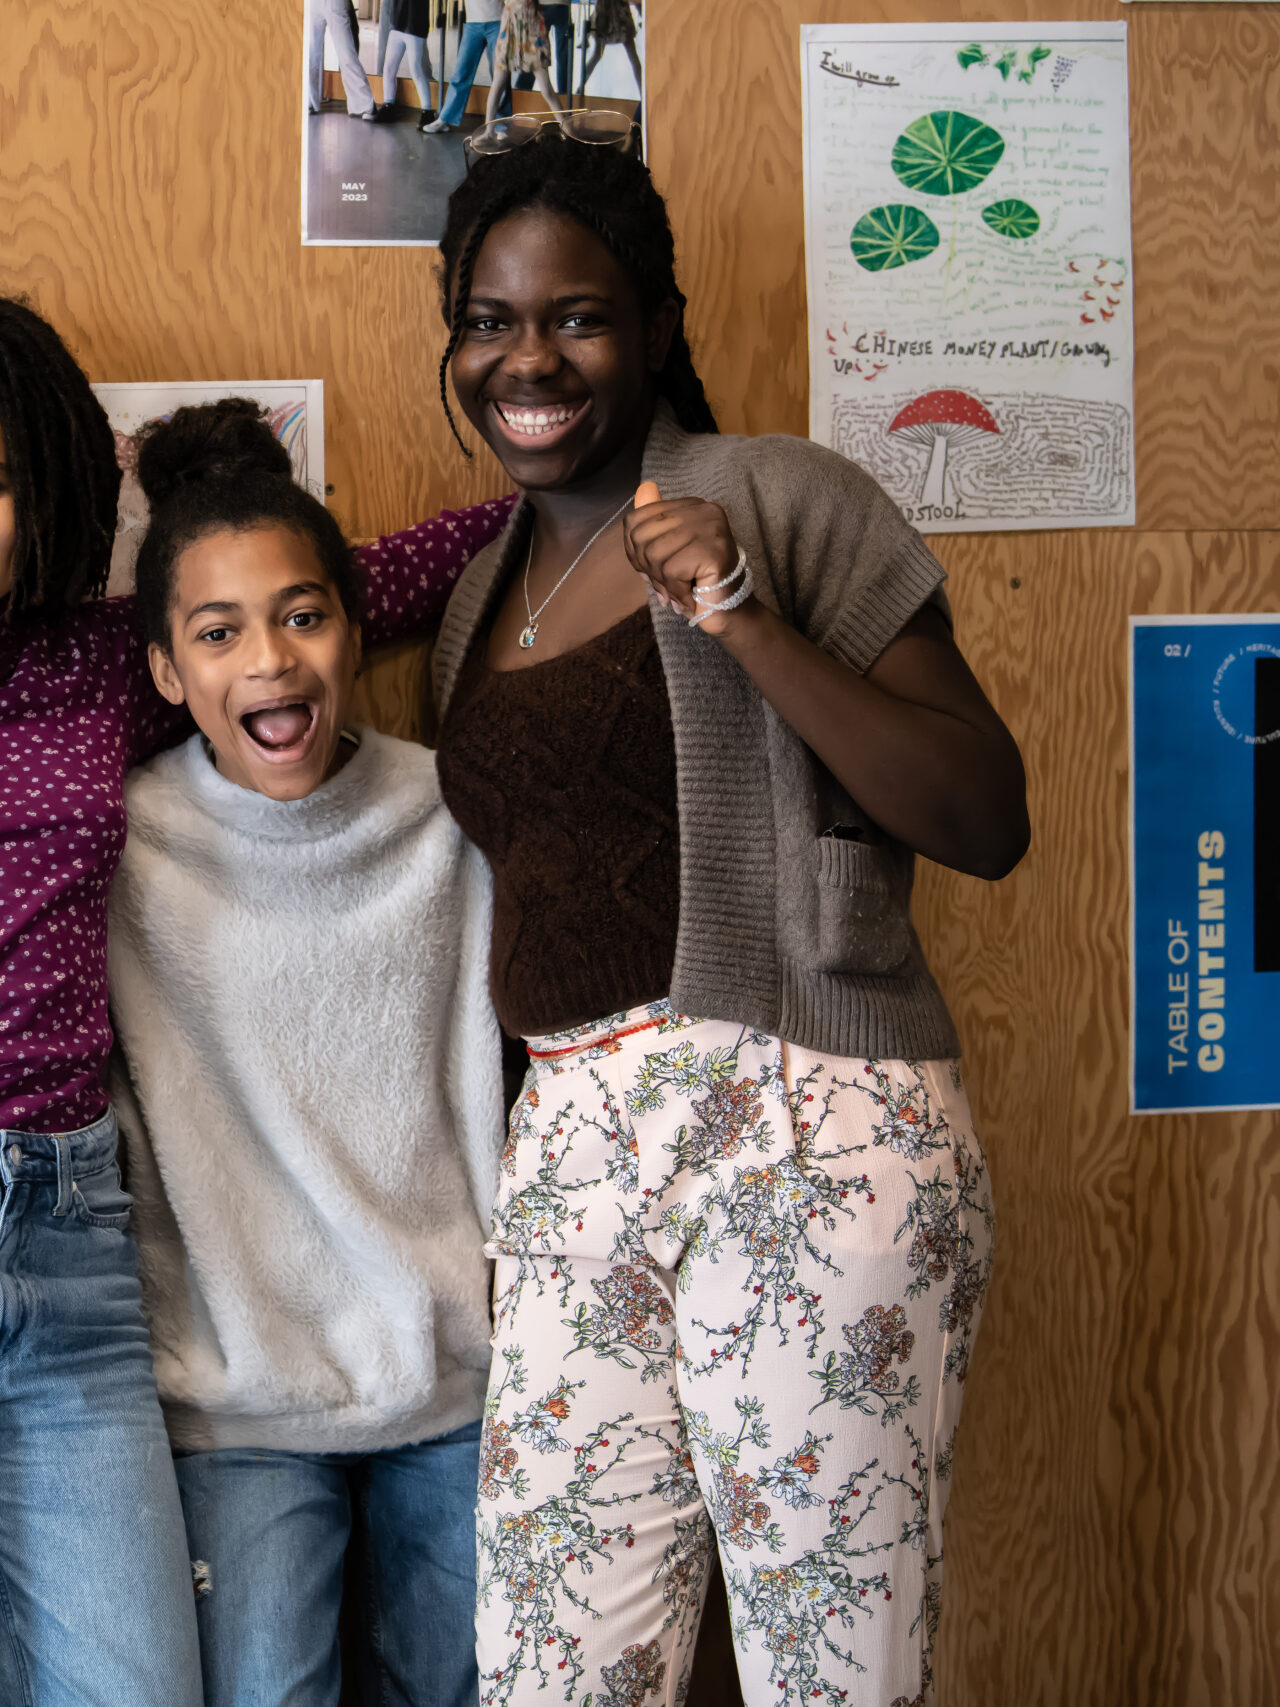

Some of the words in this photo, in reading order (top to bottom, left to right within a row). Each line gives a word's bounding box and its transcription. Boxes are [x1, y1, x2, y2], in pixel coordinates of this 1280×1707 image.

[821, 51, 832, 65] I
[341, 182, 366, 190] MAY
[855, 333, 933, 357] CHINESE
[902, 500, 967, 521] DSTOOL
[1168, 919, 1189, 965] OF
[1198, 830, 1226, 1073] CONTENTS
[1168, 973, 1189, 1074] TABLE
